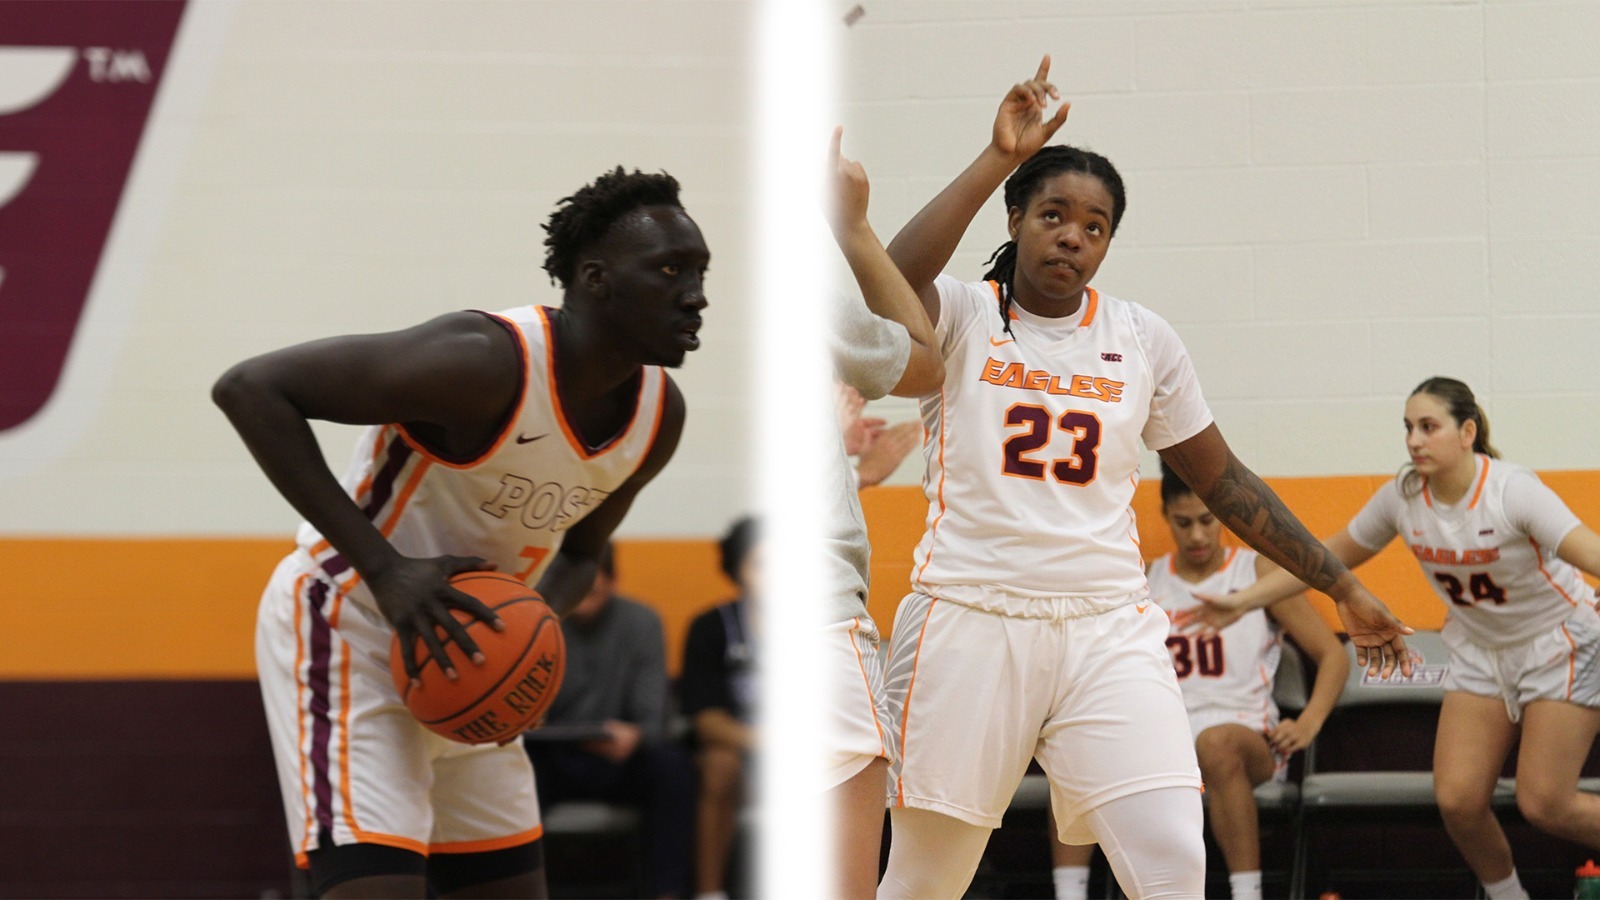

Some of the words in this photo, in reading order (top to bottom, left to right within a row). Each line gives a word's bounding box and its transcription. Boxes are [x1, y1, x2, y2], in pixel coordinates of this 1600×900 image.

[979, 357, 1124, 402] EAGLES
[1001, 402, 1103, 487] 23
[1433, 571, 1507, 607] 24
[1165, 633, 1225, 681] 30
